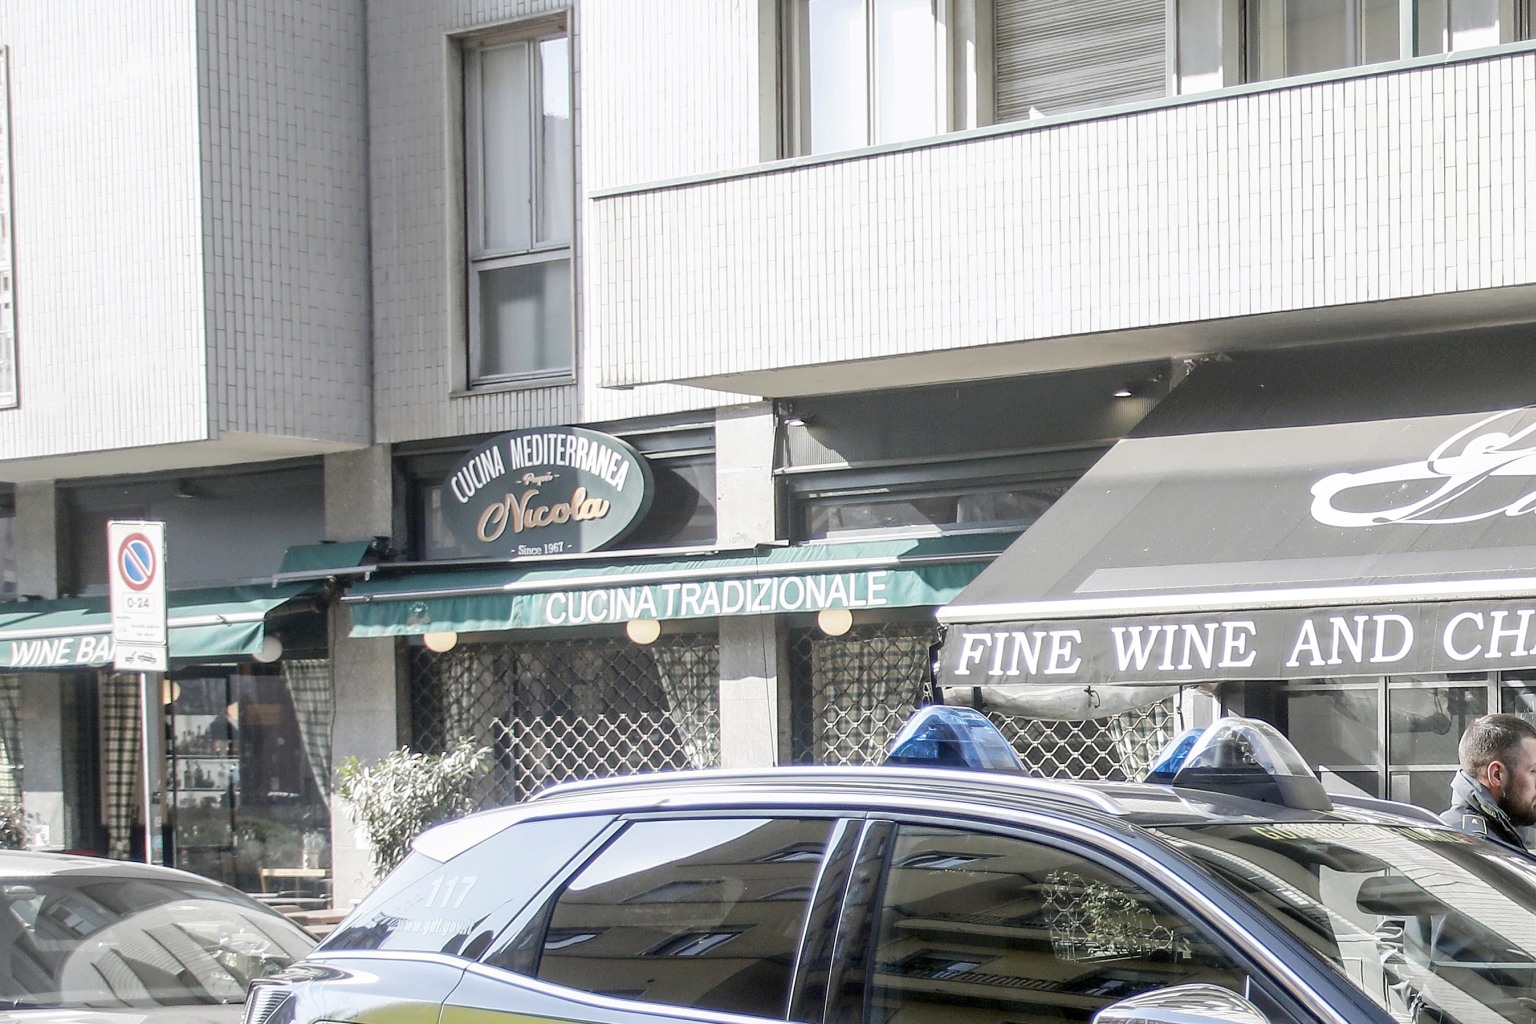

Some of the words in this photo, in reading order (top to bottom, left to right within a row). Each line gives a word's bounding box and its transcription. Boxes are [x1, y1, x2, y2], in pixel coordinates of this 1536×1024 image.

[450, 445, 505, 503] CUCINA
[510, 433, 630, 492] MEDITERRANEA
[477, 486, 610, 543] Nicola
[518, 545, 542, 555] Since
[544, 541, 563, 553] 1967
[127, 598, 149, 608] 0-24
[545, 586, 657, 625] CUCINA
[661, 570, 887, 616] TRADIZIONALE
[11, 638, 74, 666] WINE
[954, 629, 1083, 676] FINE
[1111, 621, 1258, 672] WINE
[1285, 614, 1415, 668] AND
[424, 874, 479, 909] 117
